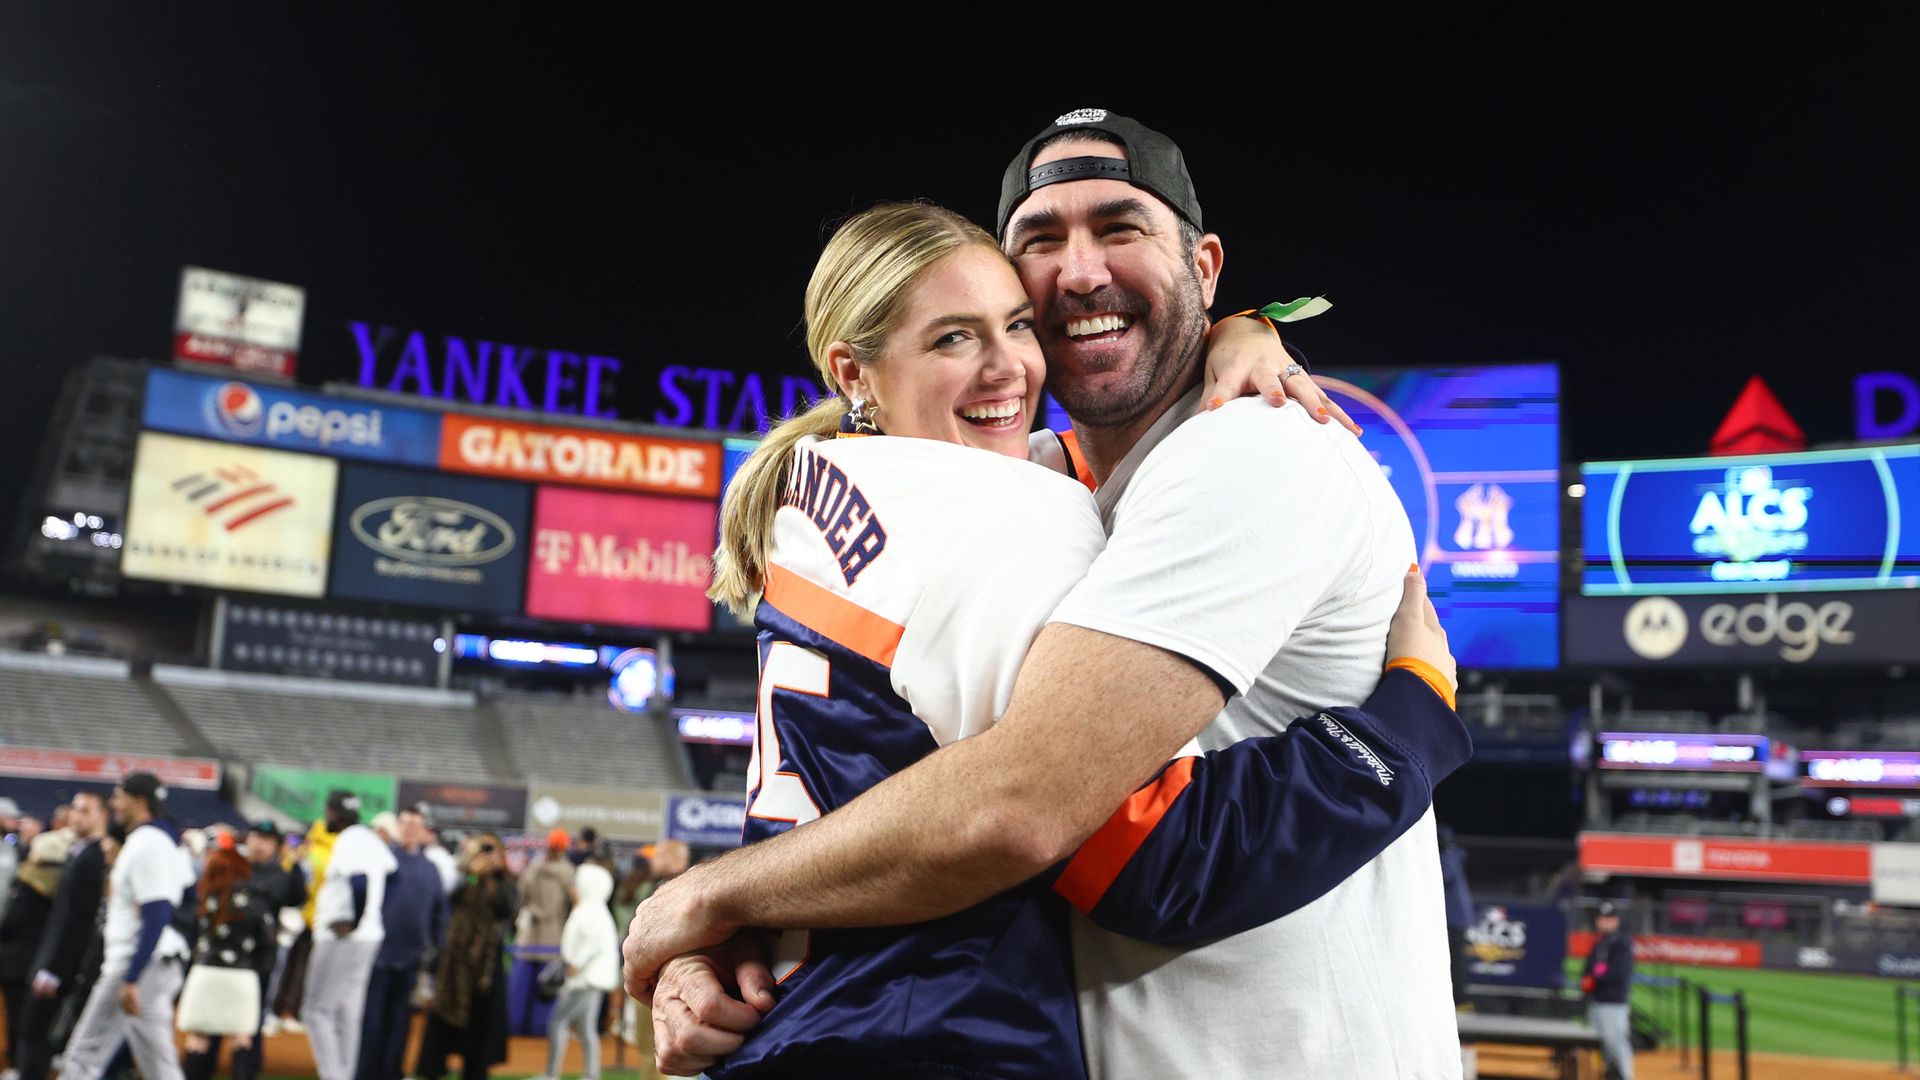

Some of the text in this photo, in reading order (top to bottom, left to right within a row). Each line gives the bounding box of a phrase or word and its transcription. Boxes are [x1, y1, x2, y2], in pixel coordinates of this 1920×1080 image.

[348, 319, 621, 421] YANKEE
[654, 365, 836, 435] STAD
[266, 401, 383, 447] pepsi
[459, 426, 704, 488] GATORADE
[378, 502, 488, 556] Ford
[1688, 486, 1813, 534] ALCS
[577, 532, 707, 588] Mobile
[1700, 593, 1855, 663] edge
[1341, 734, 1353, 743] &
